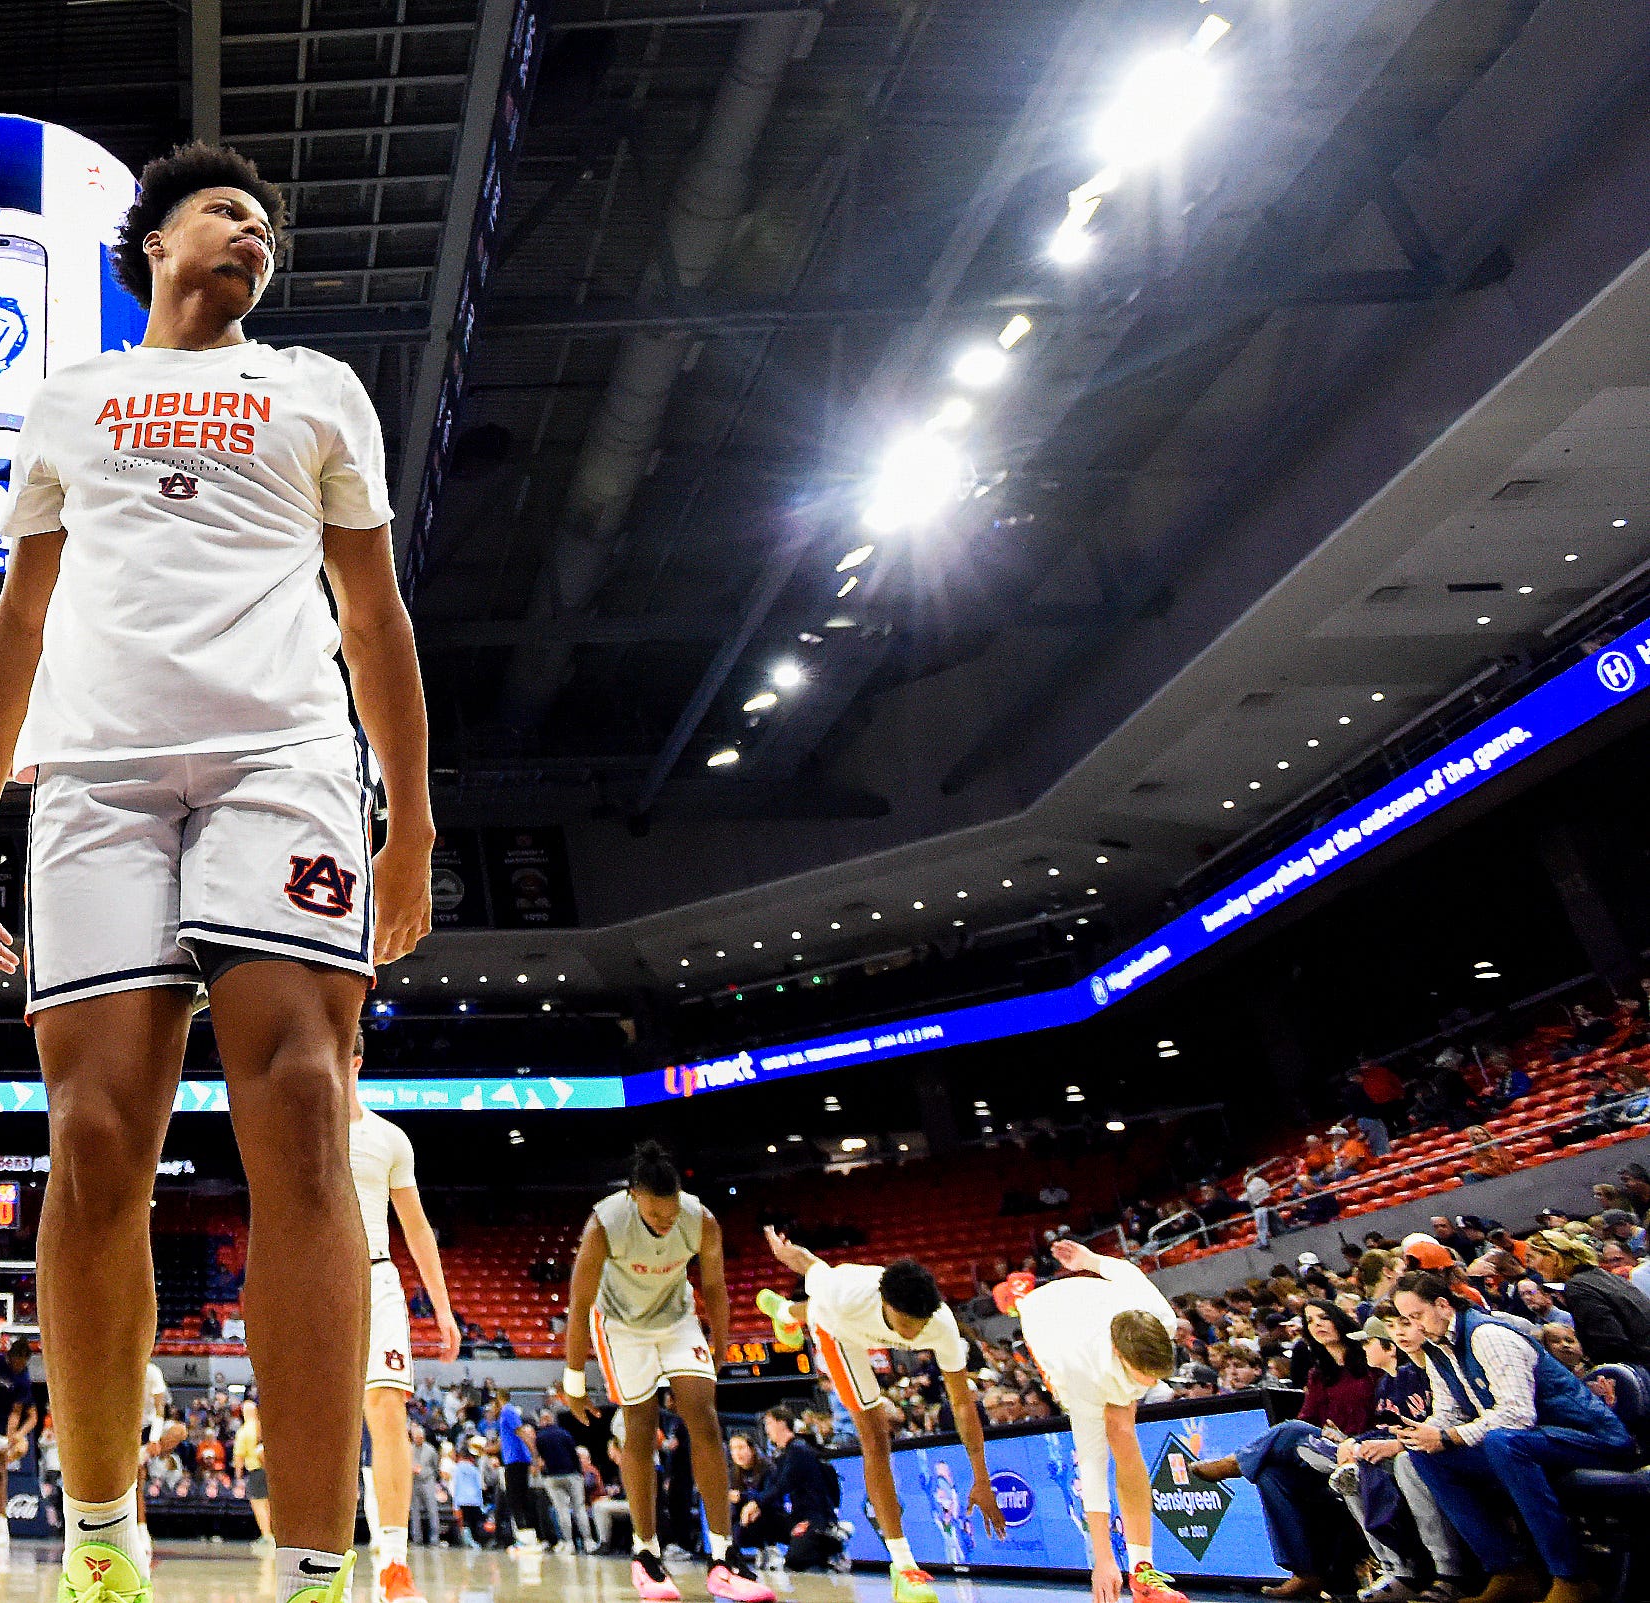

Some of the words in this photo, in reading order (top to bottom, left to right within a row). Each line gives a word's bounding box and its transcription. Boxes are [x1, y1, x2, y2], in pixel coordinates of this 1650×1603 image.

[95, 392, 271, 425] AUBURN
[108, 421, 255, 455] TIGERS
[1359, 787, 1427, 836] outcome
[1442, 756, 1475, 785] the
[1473, 726, 1533, 770] game.
[1152, 1488, 1222, 1516] Sensigreen
